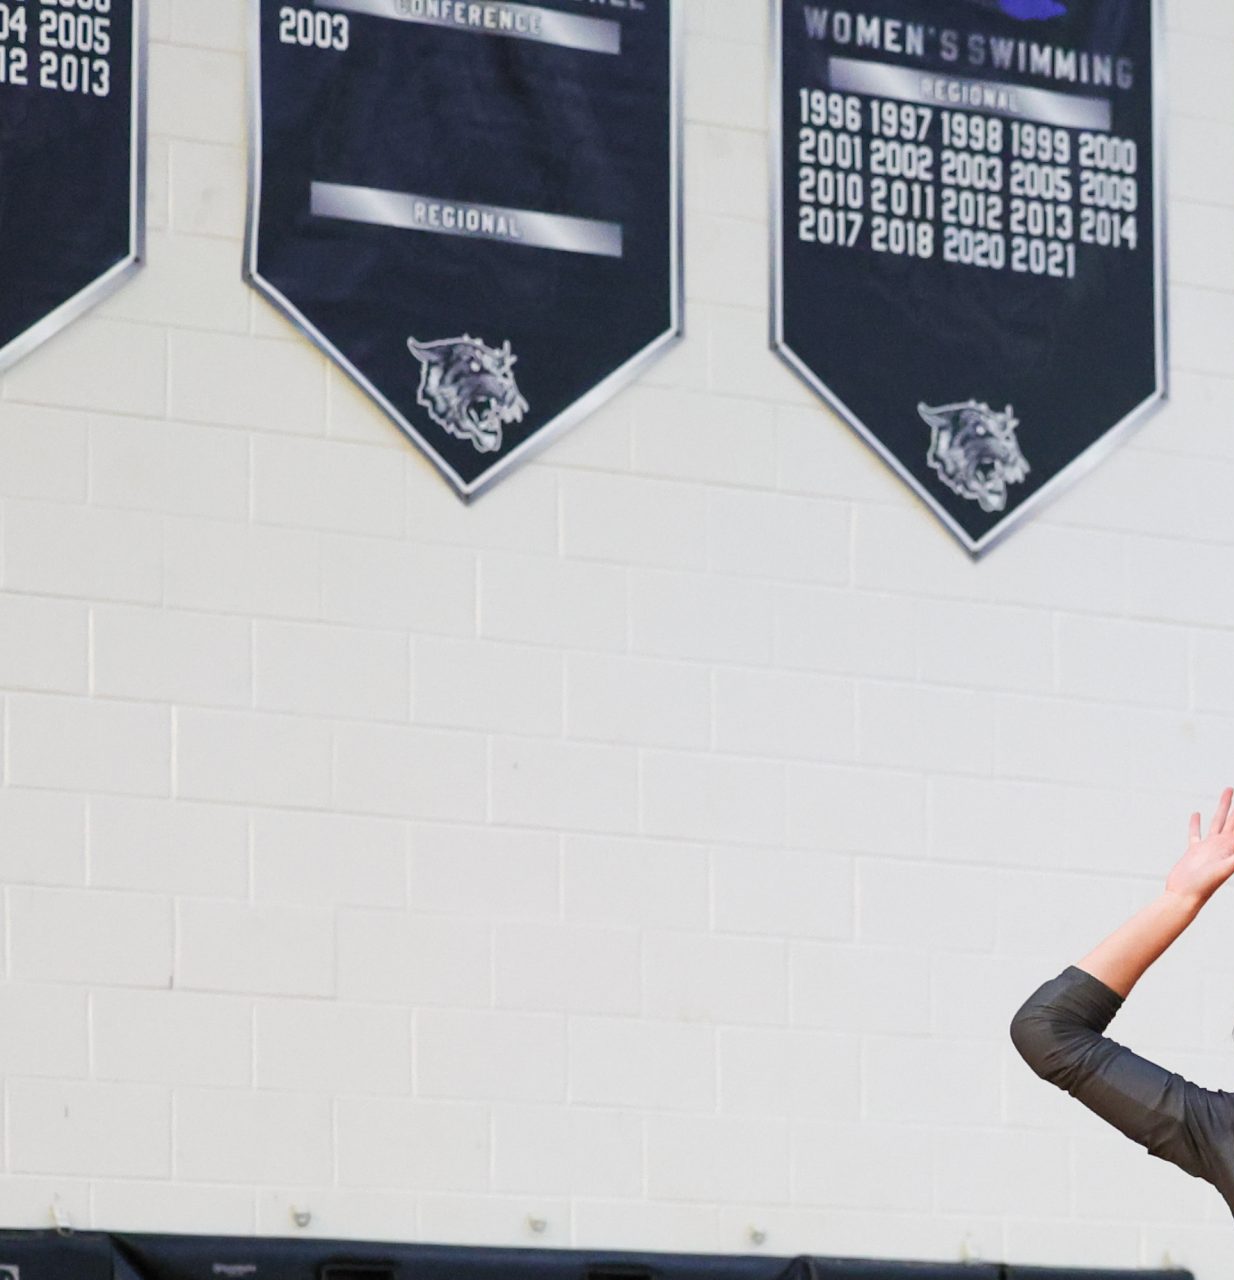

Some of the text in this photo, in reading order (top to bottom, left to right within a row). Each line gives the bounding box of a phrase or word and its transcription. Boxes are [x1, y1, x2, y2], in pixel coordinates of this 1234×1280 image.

[39, 9, 111, 55] 2005
[279, 6, 350, 51] 2003
[396, 0, 542, 35] CONFERENCE
[803, 6, 1134, 89] WOMEN'S SWIMMING
[39, 51, 110, 97] 2013
[919, 77, 1019, 113] REGIONAL
[799, 88, 1137, 174] 1996 1997 1998 1999 2000
[799, 128, 1137, 212] 2001 2002 2003 2005 2009
[413, 202, 521, 239] REGIONAL
[799, 167, 1137, 249] 2010 2011 2012 2013 2014
[799, 205, 1075, 279] 2017 2018 2020 2021
